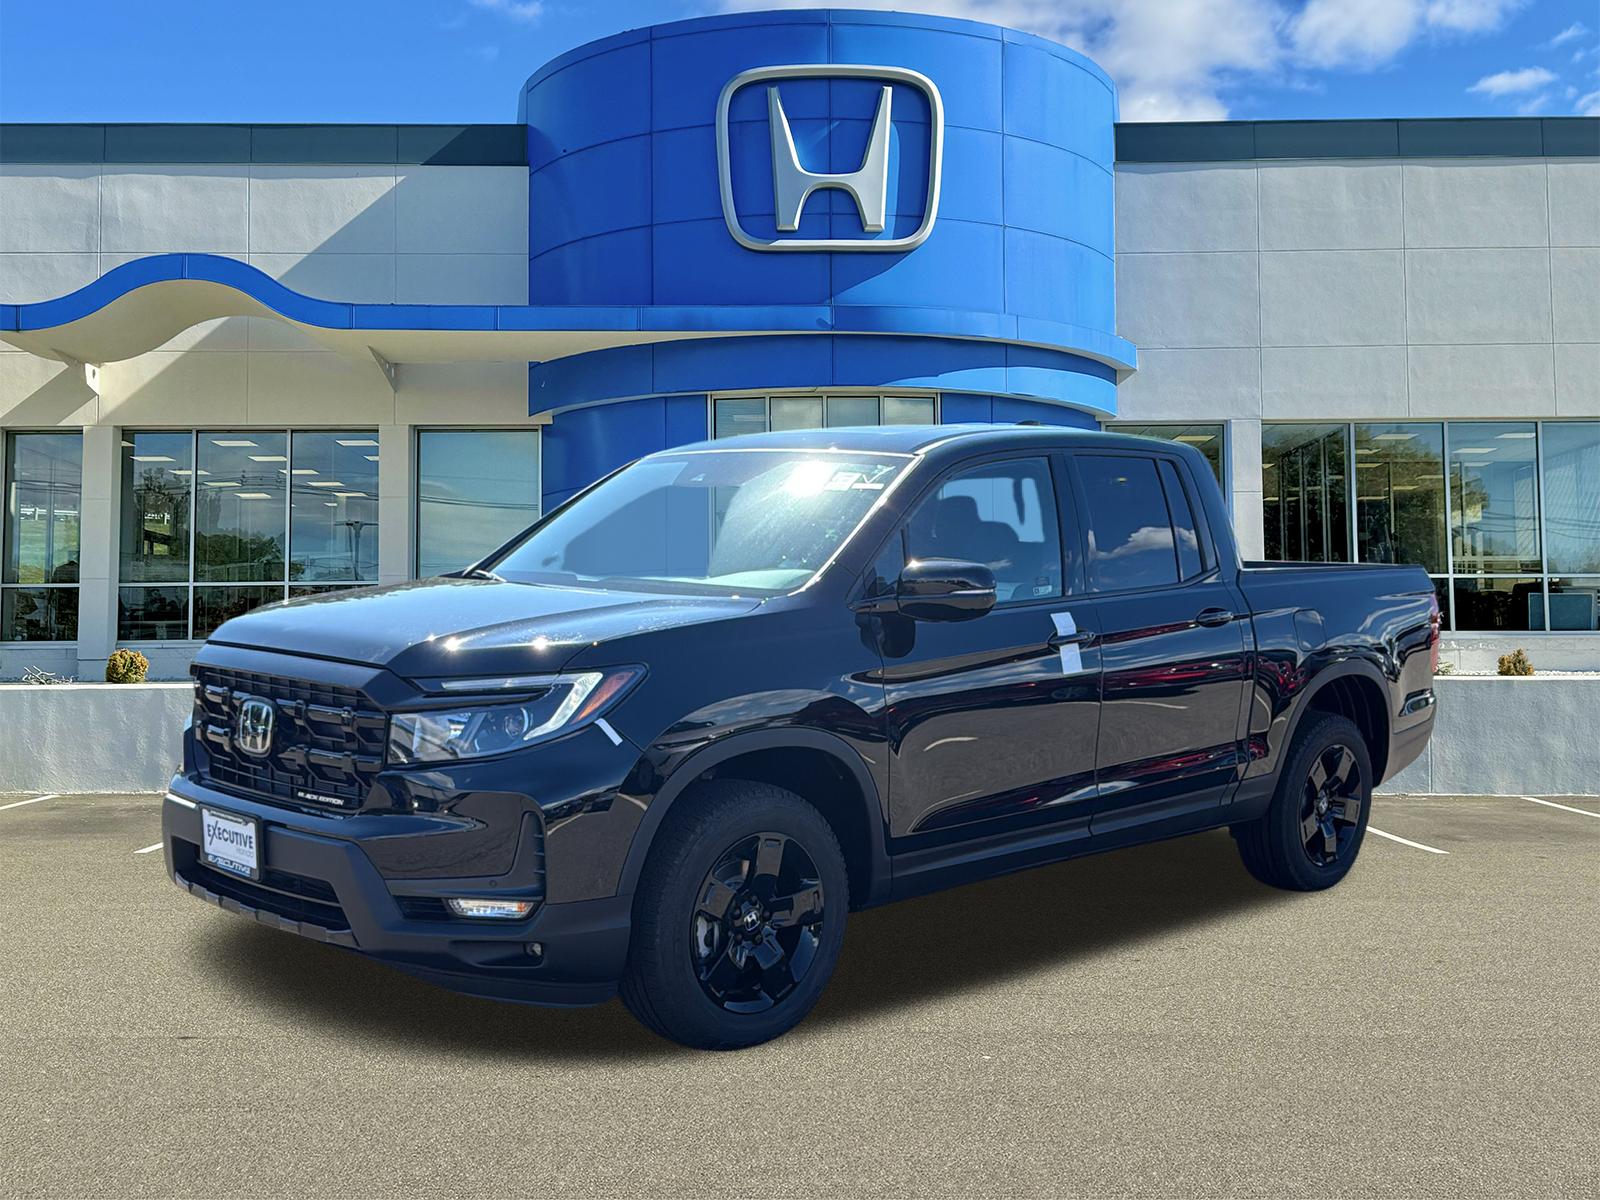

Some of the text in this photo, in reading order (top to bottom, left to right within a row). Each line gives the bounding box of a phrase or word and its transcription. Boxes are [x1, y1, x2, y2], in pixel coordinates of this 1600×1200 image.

[767, 86, 893, 233] H
[318, 795, 345, 806] EDITION
[206, 820, 254, 849] EXECUTIVE
